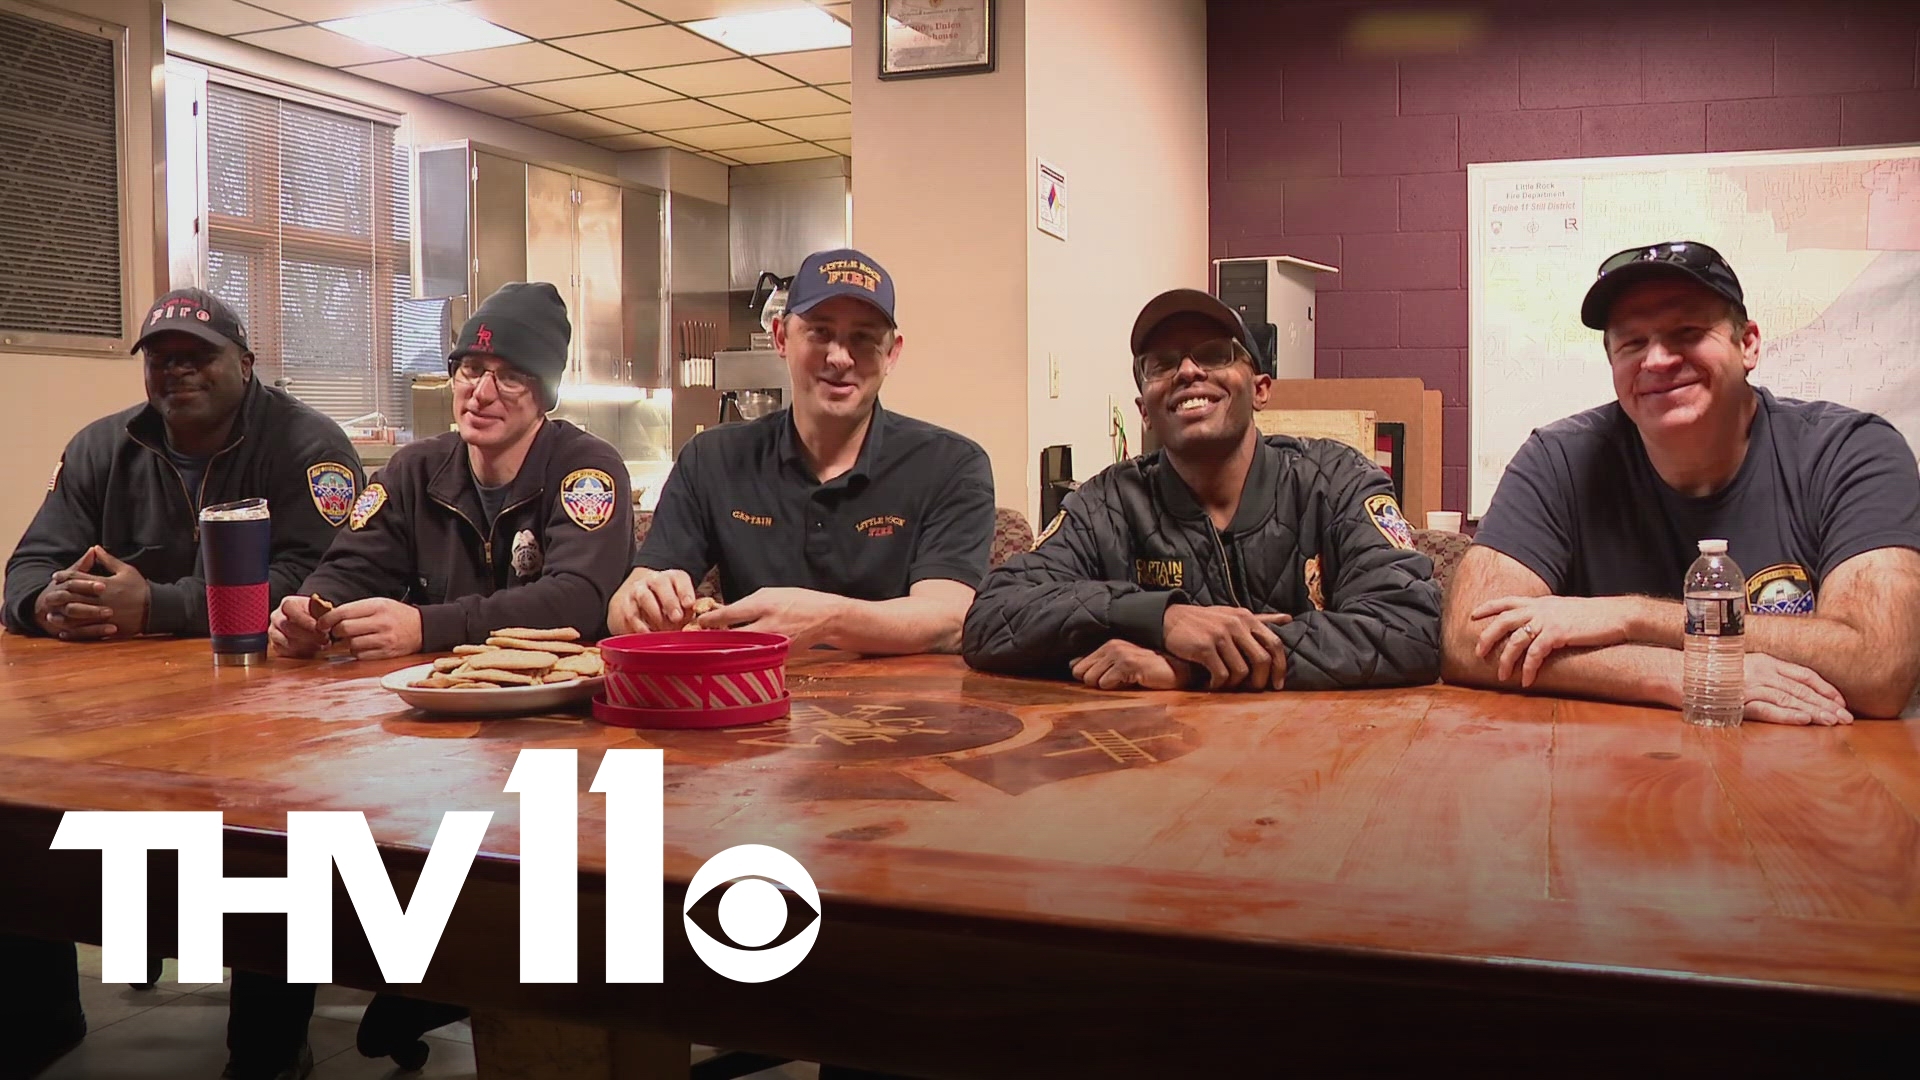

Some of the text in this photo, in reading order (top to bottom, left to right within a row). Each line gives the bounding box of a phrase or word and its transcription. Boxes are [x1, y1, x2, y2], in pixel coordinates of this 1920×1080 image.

[936, 22, 961, 30] Union
[1515, 182, 1555, 191] Little Rock
[1522, 190, 1565, 200] Department
[1492, 203, 1519, 213] Engine
[1521, 203, 1529, 211] 11
[1547, 201, 1576, 211] District
[818, 260, 858, 274] LITTLE
[826, 271, 876, 293] FIRE
[731, 510, 773, 527] CAPTAIN
[855, 516, 884, 532] LITTLE
